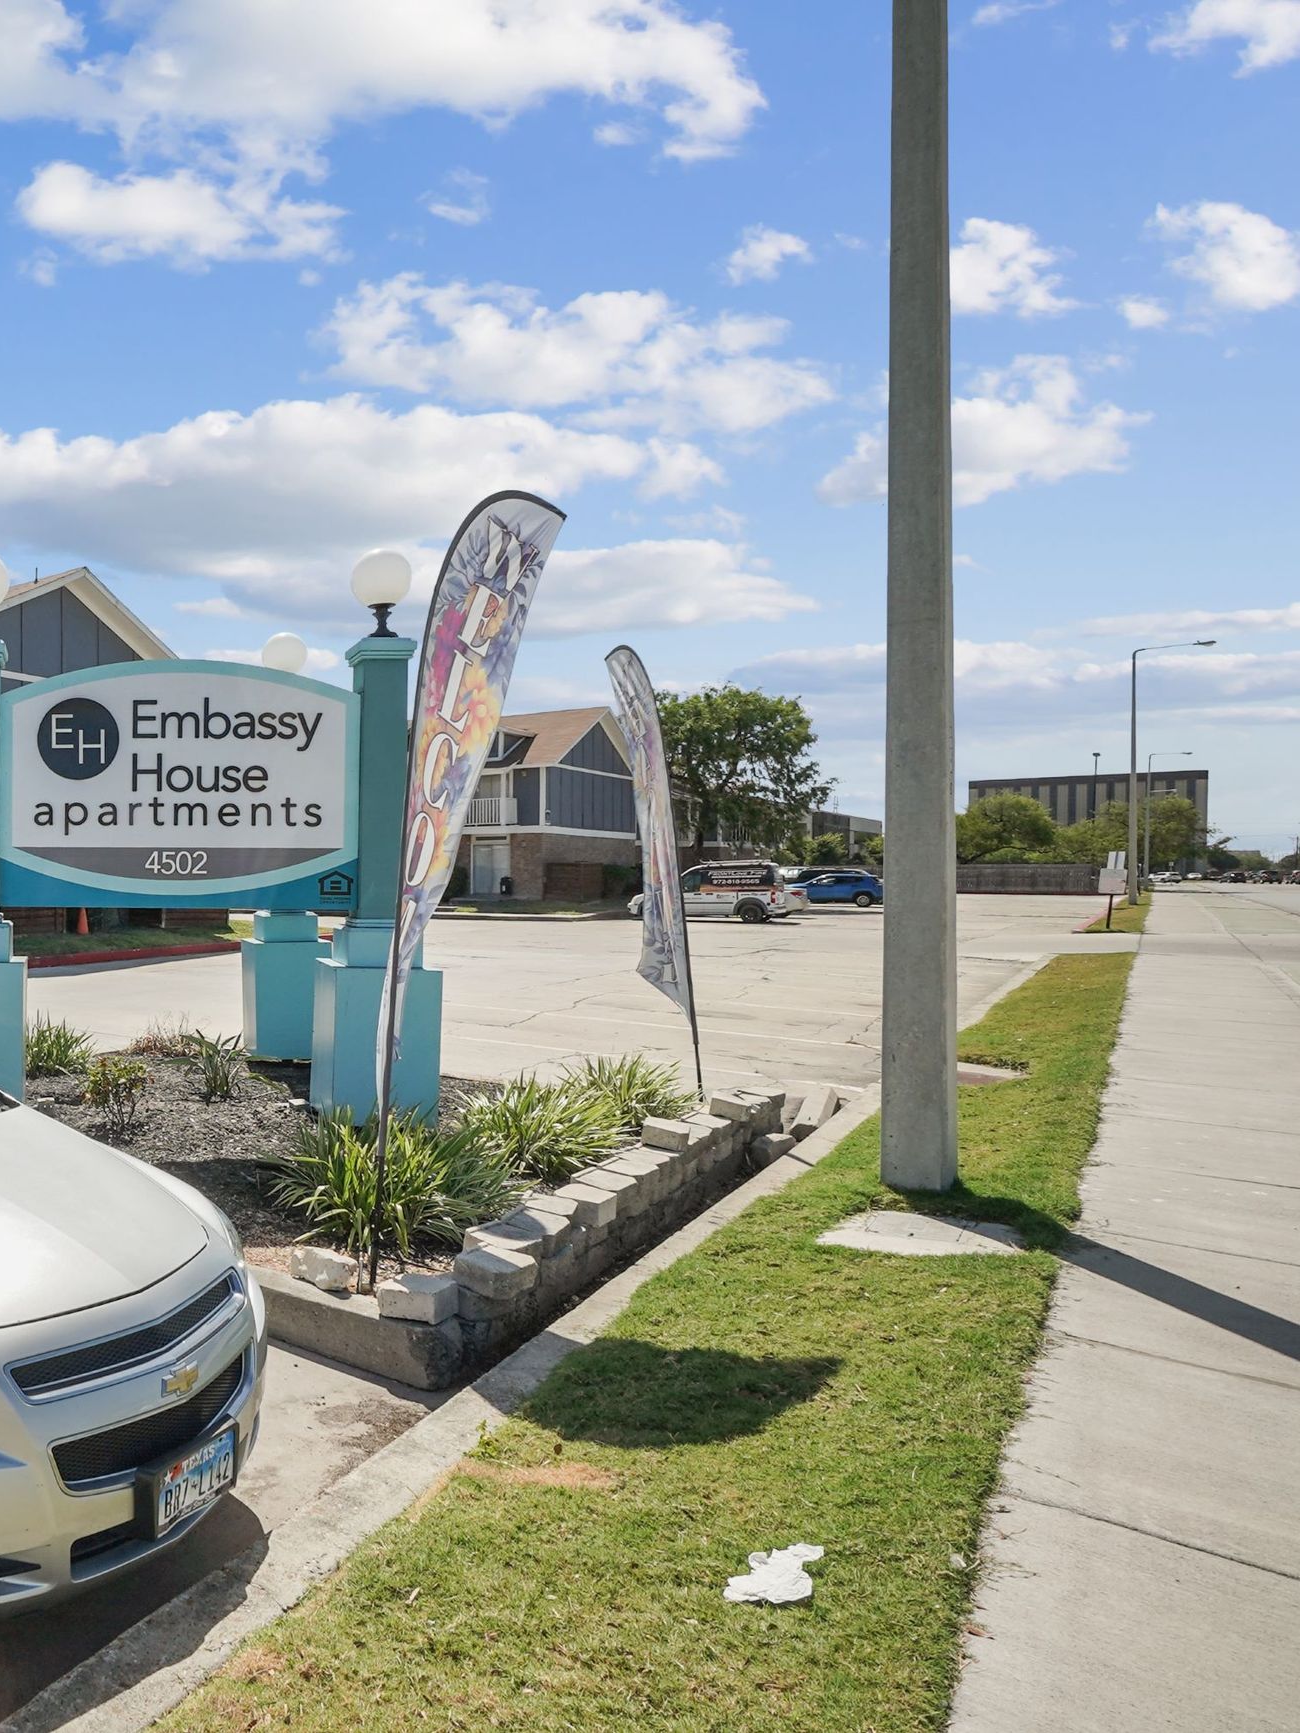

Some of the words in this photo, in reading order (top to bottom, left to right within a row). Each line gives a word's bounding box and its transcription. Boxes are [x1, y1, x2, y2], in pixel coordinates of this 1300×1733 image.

[50, 713, 107, 764] EH
[131, 696, 323, 752] Embassy
[131, 752, 269, 793] House
[33, 796, 323, 836] apartments
[144, 850, 208, 875] 4502
[182, 1444, 216, 1473] TEXAS
